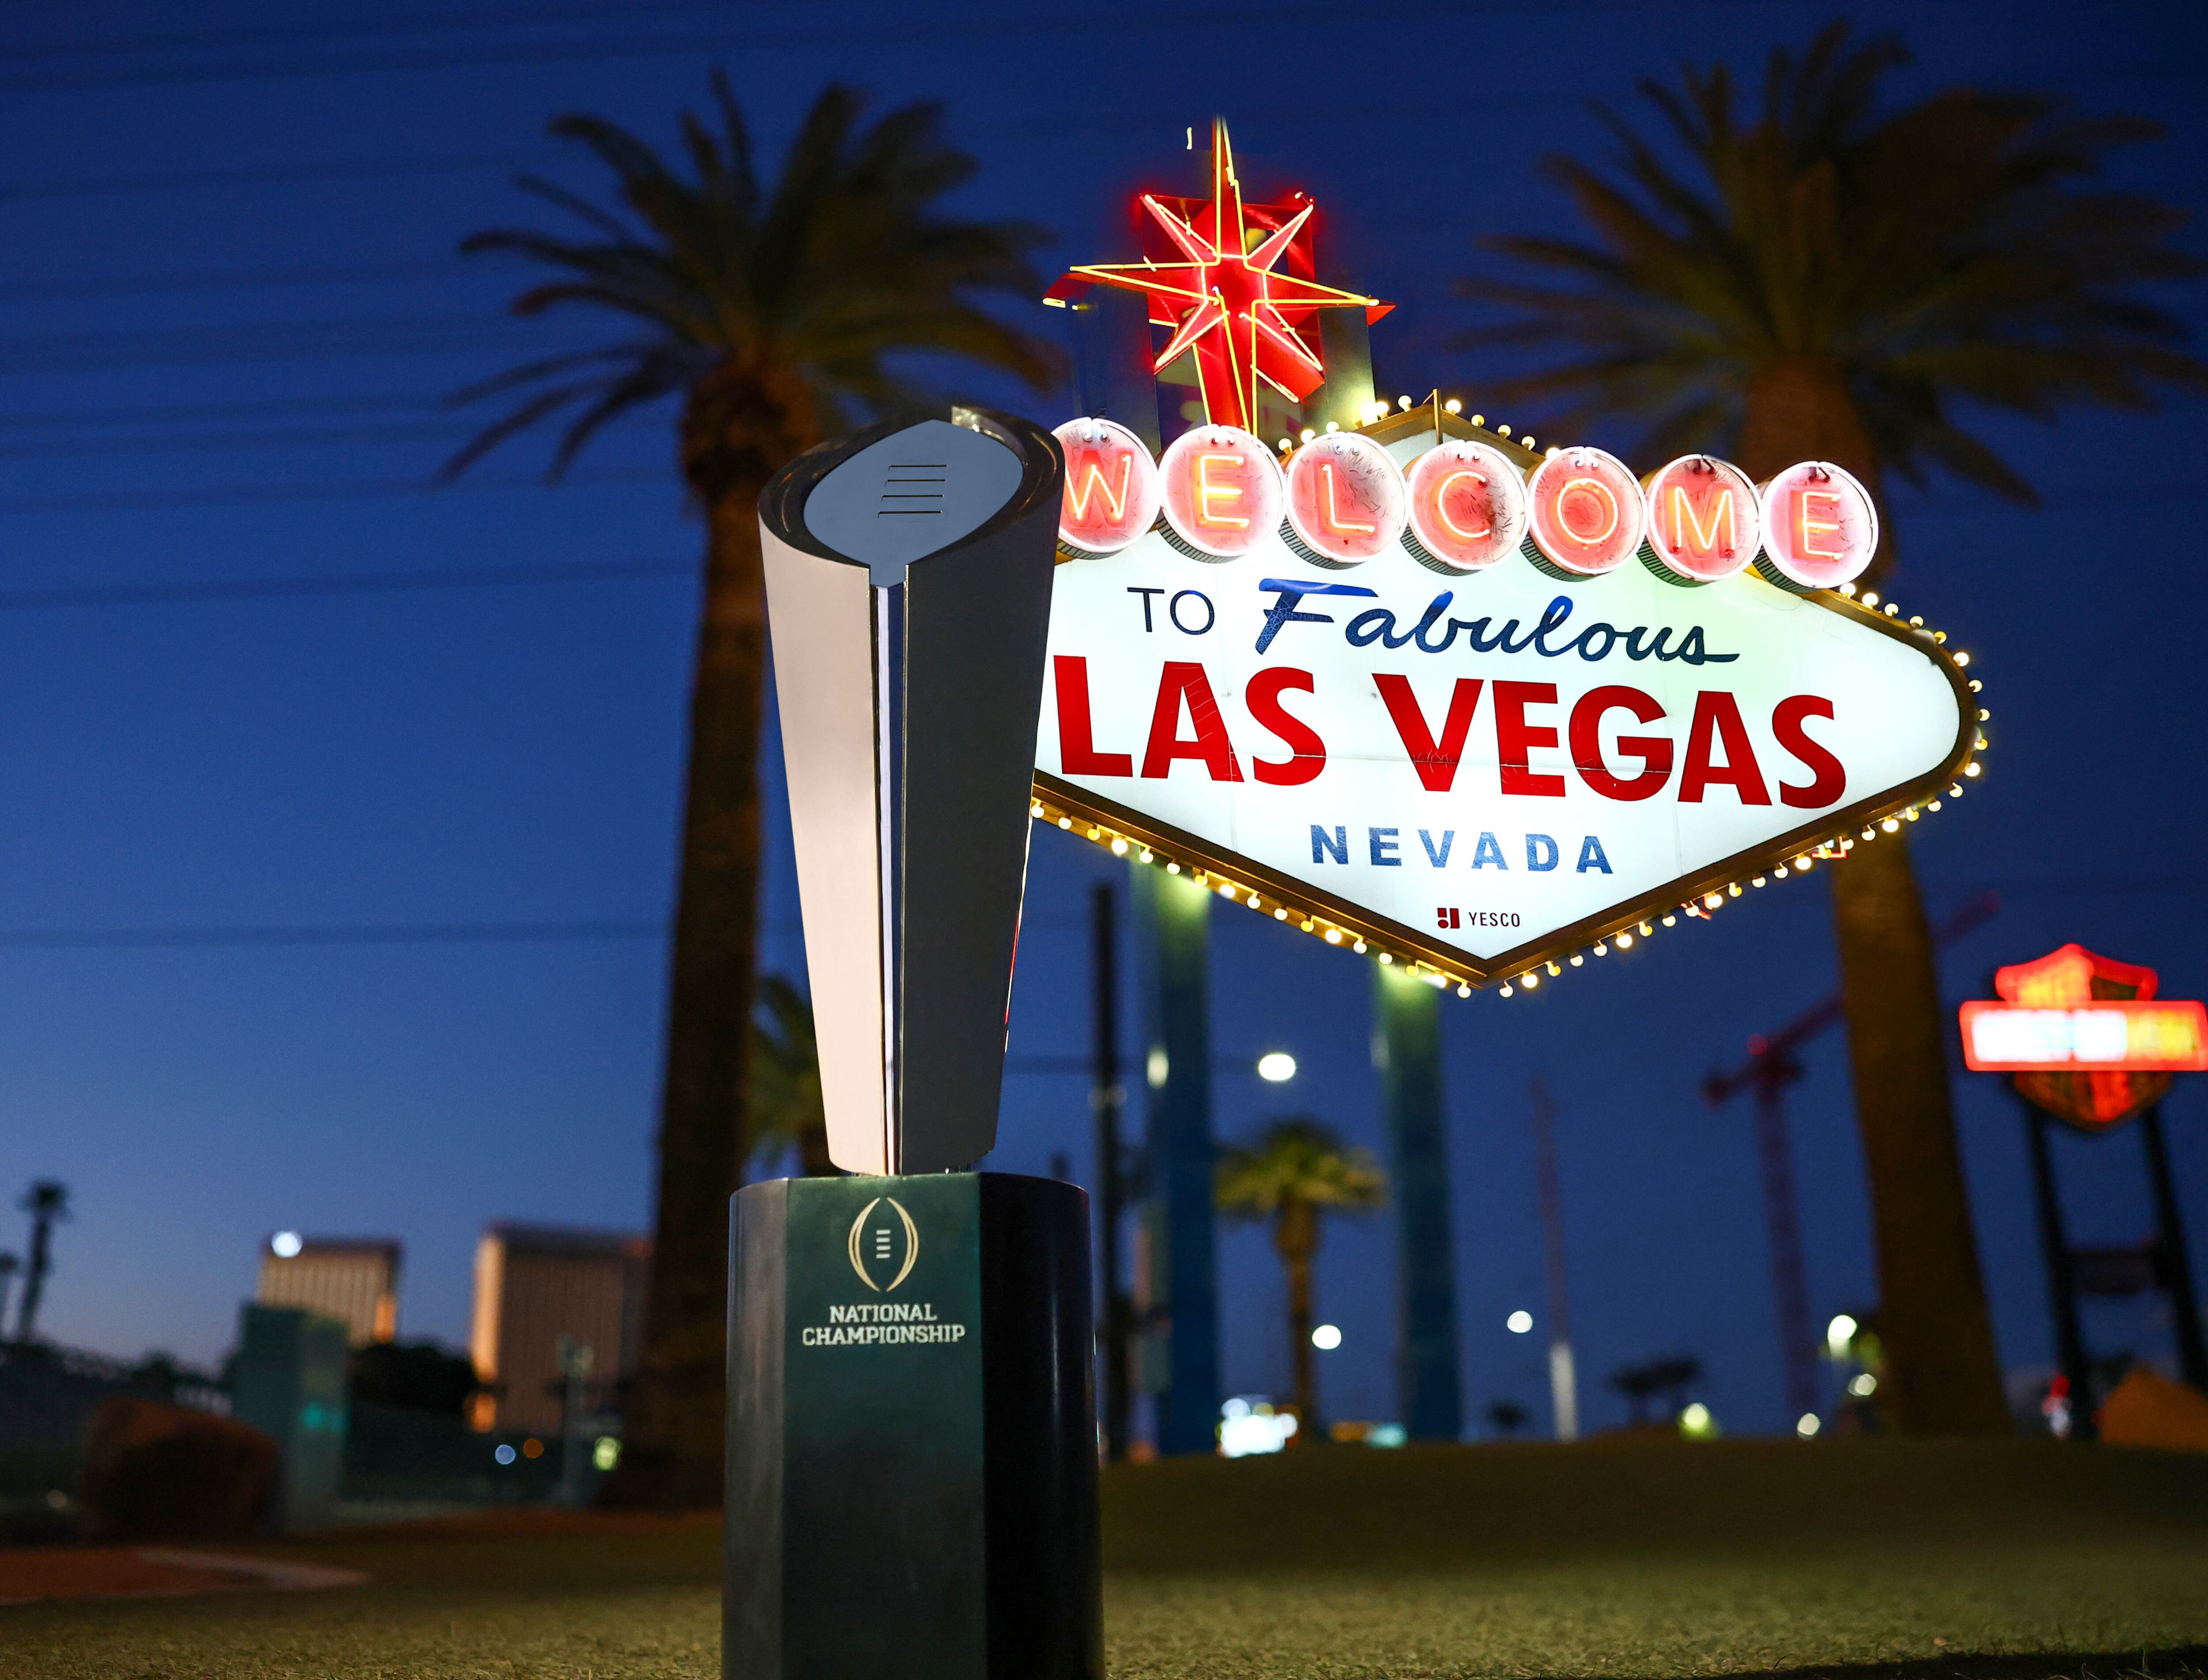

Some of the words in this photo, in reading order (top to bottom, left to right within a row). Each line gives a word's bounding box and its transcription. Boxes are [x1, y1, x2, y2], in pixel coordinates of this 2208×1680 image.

[1064, 450, 1845, 561] WELCOME
[1126, 587, 1215, 635] TO
[1255, 578, 1740, 666] Fabulous
[1053, 655, 1327, 787] LAS
[1373, 673, 1847, 809] VEGAS
[1310, 824, 1614, 875] NEVADA
[1468, 912, 1520, 927] YESCO
[802, 1324, 966, 1346] CHAMPIONSHIP
[829, 1303, 937, 1323] NATIONAL
